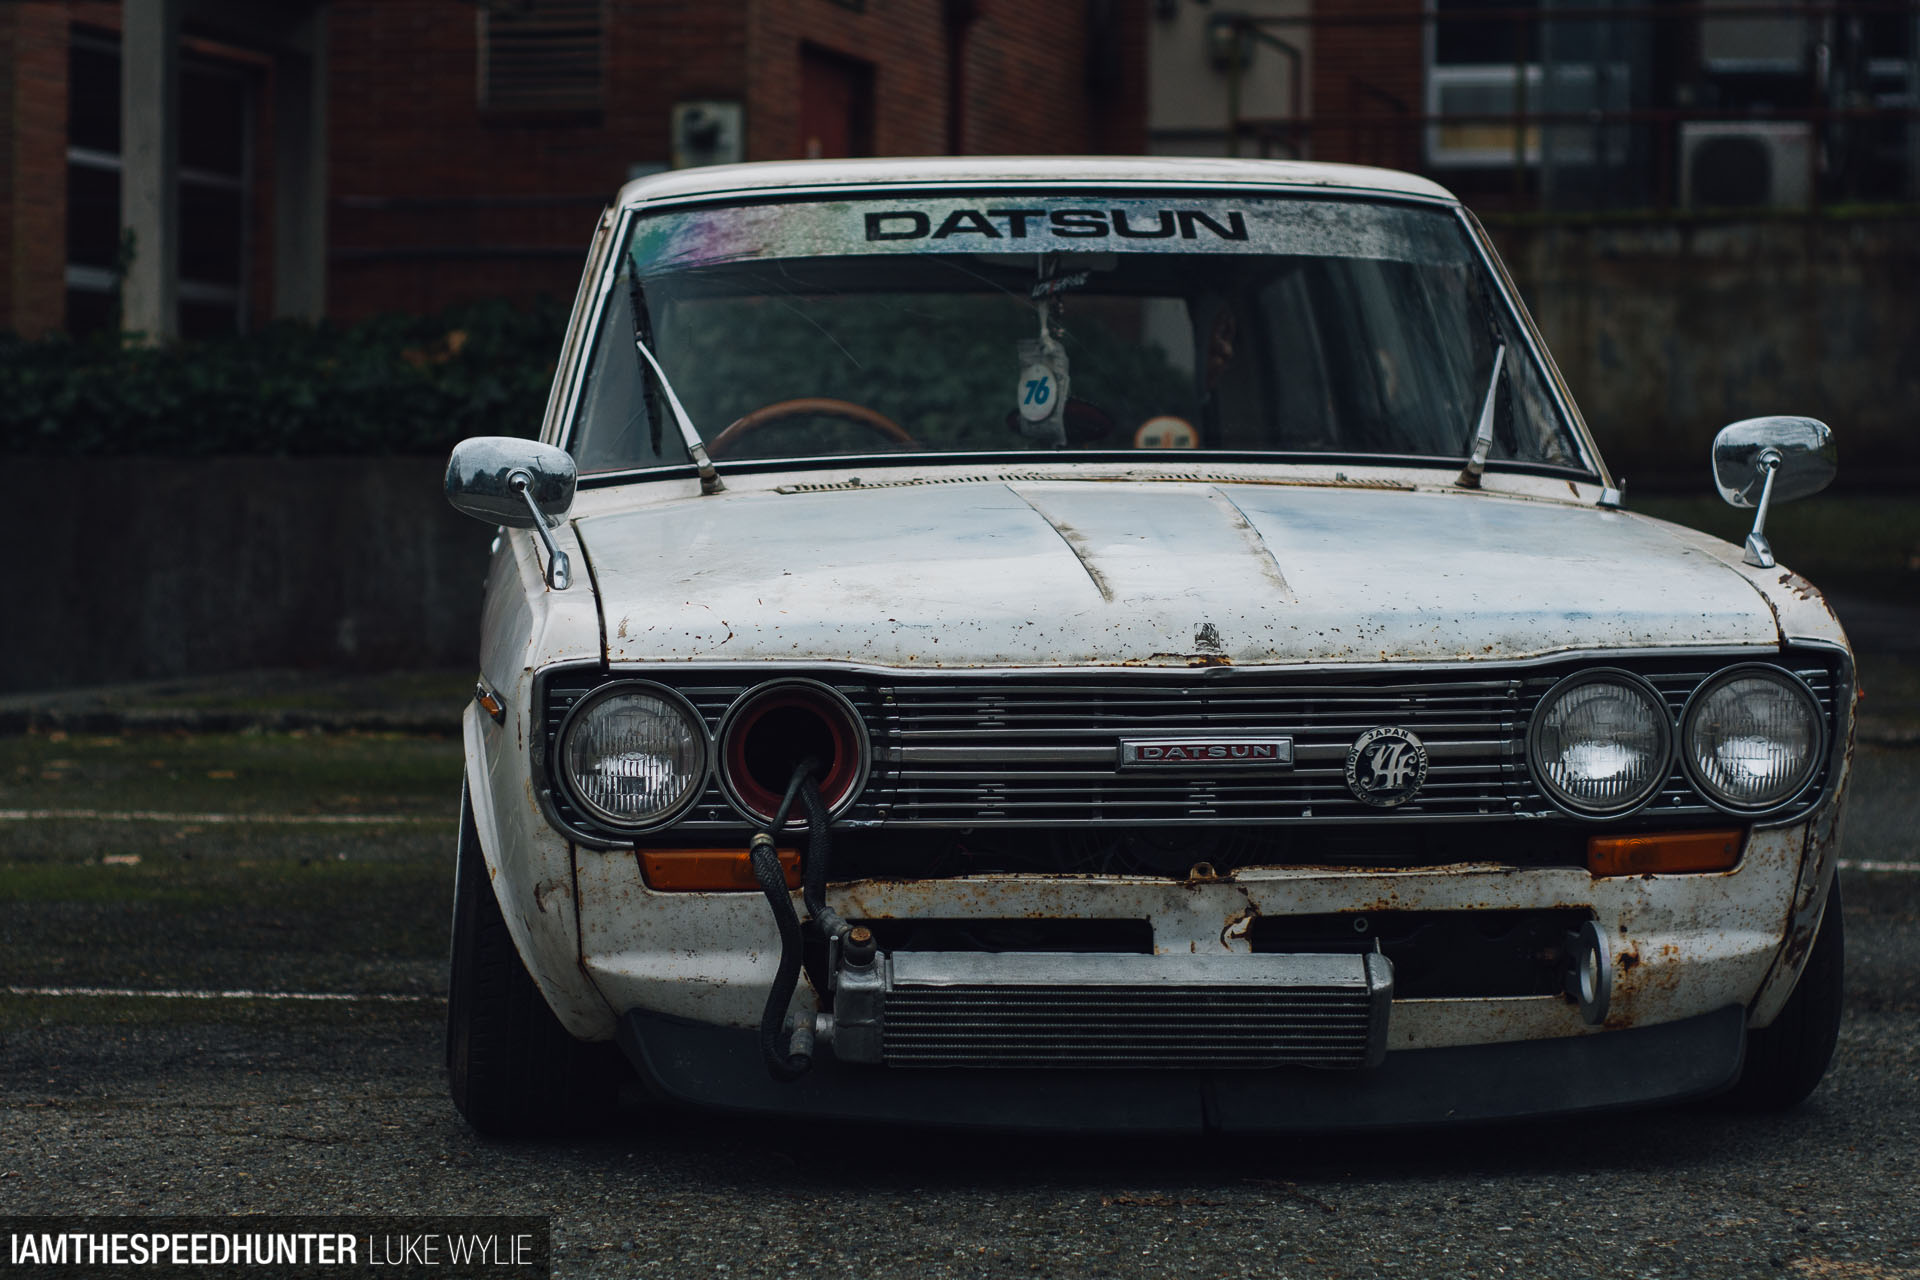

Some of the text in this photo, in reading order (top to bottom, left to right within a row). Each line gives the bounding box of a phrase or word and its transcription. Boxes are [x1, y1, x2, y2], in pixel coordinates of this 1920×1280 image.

[864, 209, 1249, 241] DATSUN
[1023, 376, 1050, 405] 76
[1367, 728, 1409, 740] JAPAN
[1143, 745, 1271, 759] DATSUN
